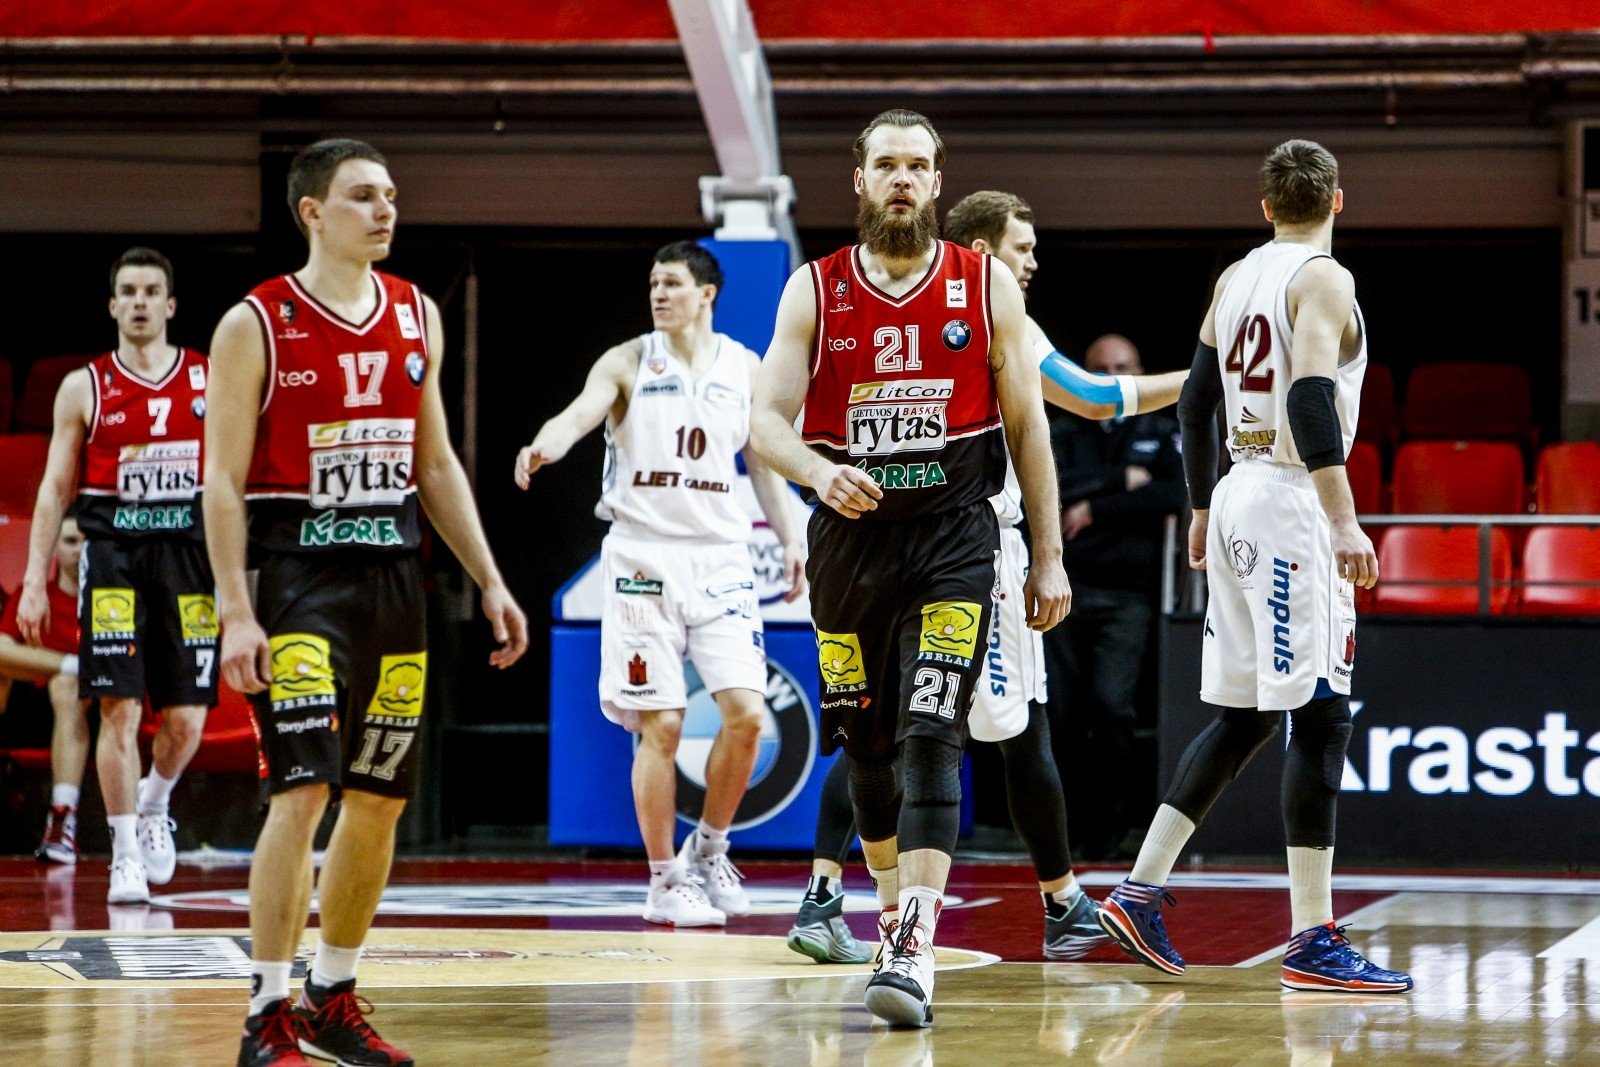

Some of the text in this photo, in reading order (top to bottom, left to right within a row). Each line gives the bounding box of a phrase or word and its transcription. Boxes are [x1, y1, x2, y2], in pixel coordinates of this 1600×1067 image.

[828, 337, 857, 351] teo
[874, 325, 922, 373] 21
[1225, 314, 1275, 394] 42
[278, 370, 318, 387] teo
[338, 351, 388, 408] 17
[875, 383, 952, 400] LitCon
[147, 398, 172, 436] 7
[851, 408, 942, 452] rytas
[852, 408, 892, 418] LIETUVOS
[676, 426, 706, 461] 10
[123, 464, 196, 500] rytas
[317, 452, 408, 503] rytas
[632, 471, 682, 487] LIET
[855, 459, 947, 490] ORFA
[1268, 557, 1299, 675] impuls
[196, 648, 214, 688] 7
[917, 650, 972, 668] PERLAS
[909, 667, 961, 720] 21
[349, 728, 415, 781] 17
[1341, 700, 1600, 797] rast
